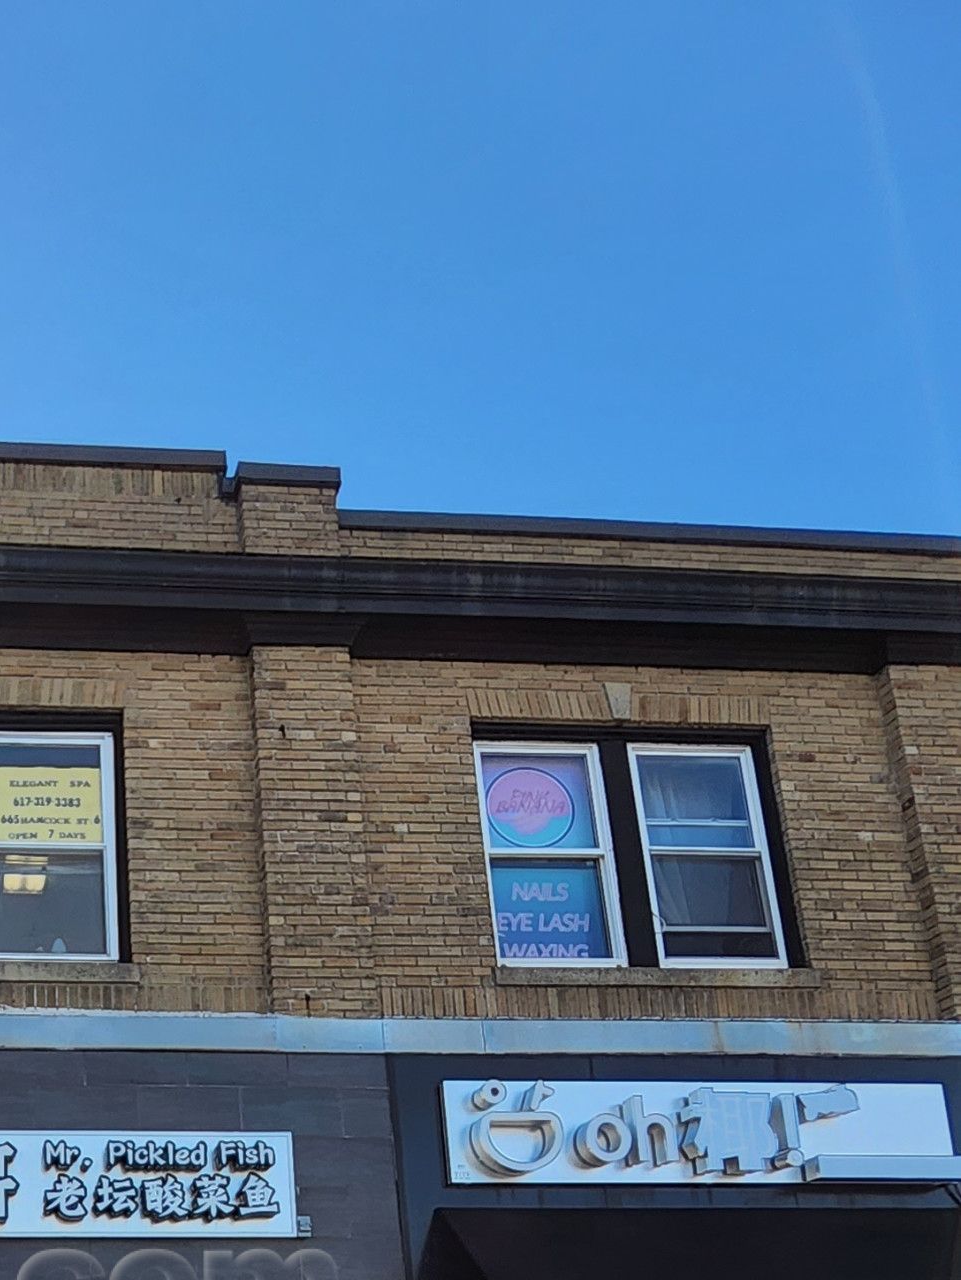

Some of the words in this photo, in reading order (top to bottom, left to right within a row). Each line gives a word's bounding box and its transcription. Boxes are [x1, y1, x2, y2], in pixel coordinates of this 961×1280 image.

[48, 829, 54, 838] 7
[511, 882, 569, 901] NAILS
[498, 912, 534, 932] EYE
[539, 912, 590, 932] LASH
[503, 943, 589, 958] WAXING
[43, 1139, 93, 1173] Mr.
[104, 1140, 207, 1172] Pickled
[216, 1140, 276, 1171] Fish
[43, 1172, 281, 1223] 老坛酸菜鱼
